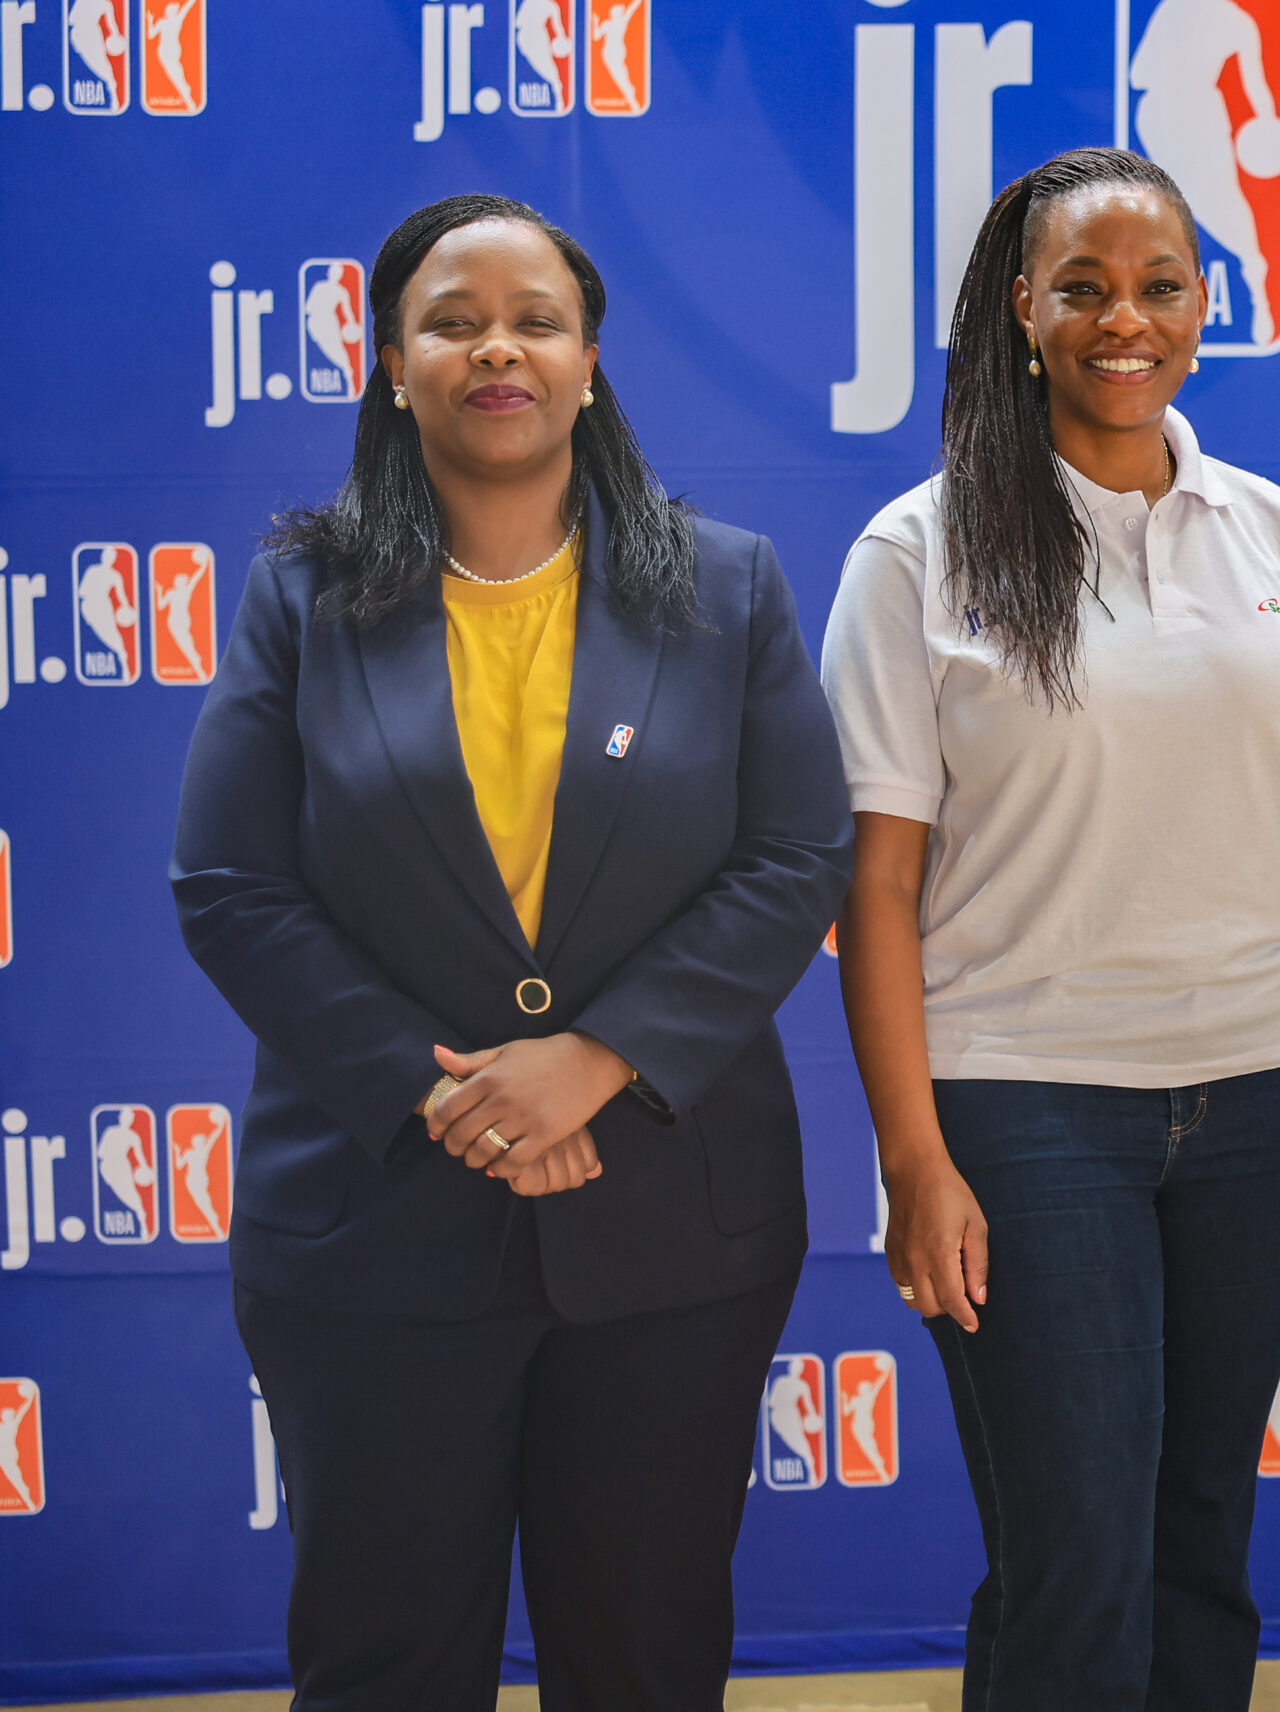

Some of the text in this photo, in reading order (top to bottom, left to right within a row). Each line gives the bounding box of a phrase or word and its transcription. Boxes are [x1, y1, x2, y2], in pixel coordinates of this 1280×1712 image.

[73, 80, 105, 105] NBA
[413, 0, 501, 142] jr.
[205, 260, 293, 427] jr.
[312, 368, 342, 393] NBA
[1, 1108, 86, 1270] jr.
[104, 1210, 136, 1235] NBA
